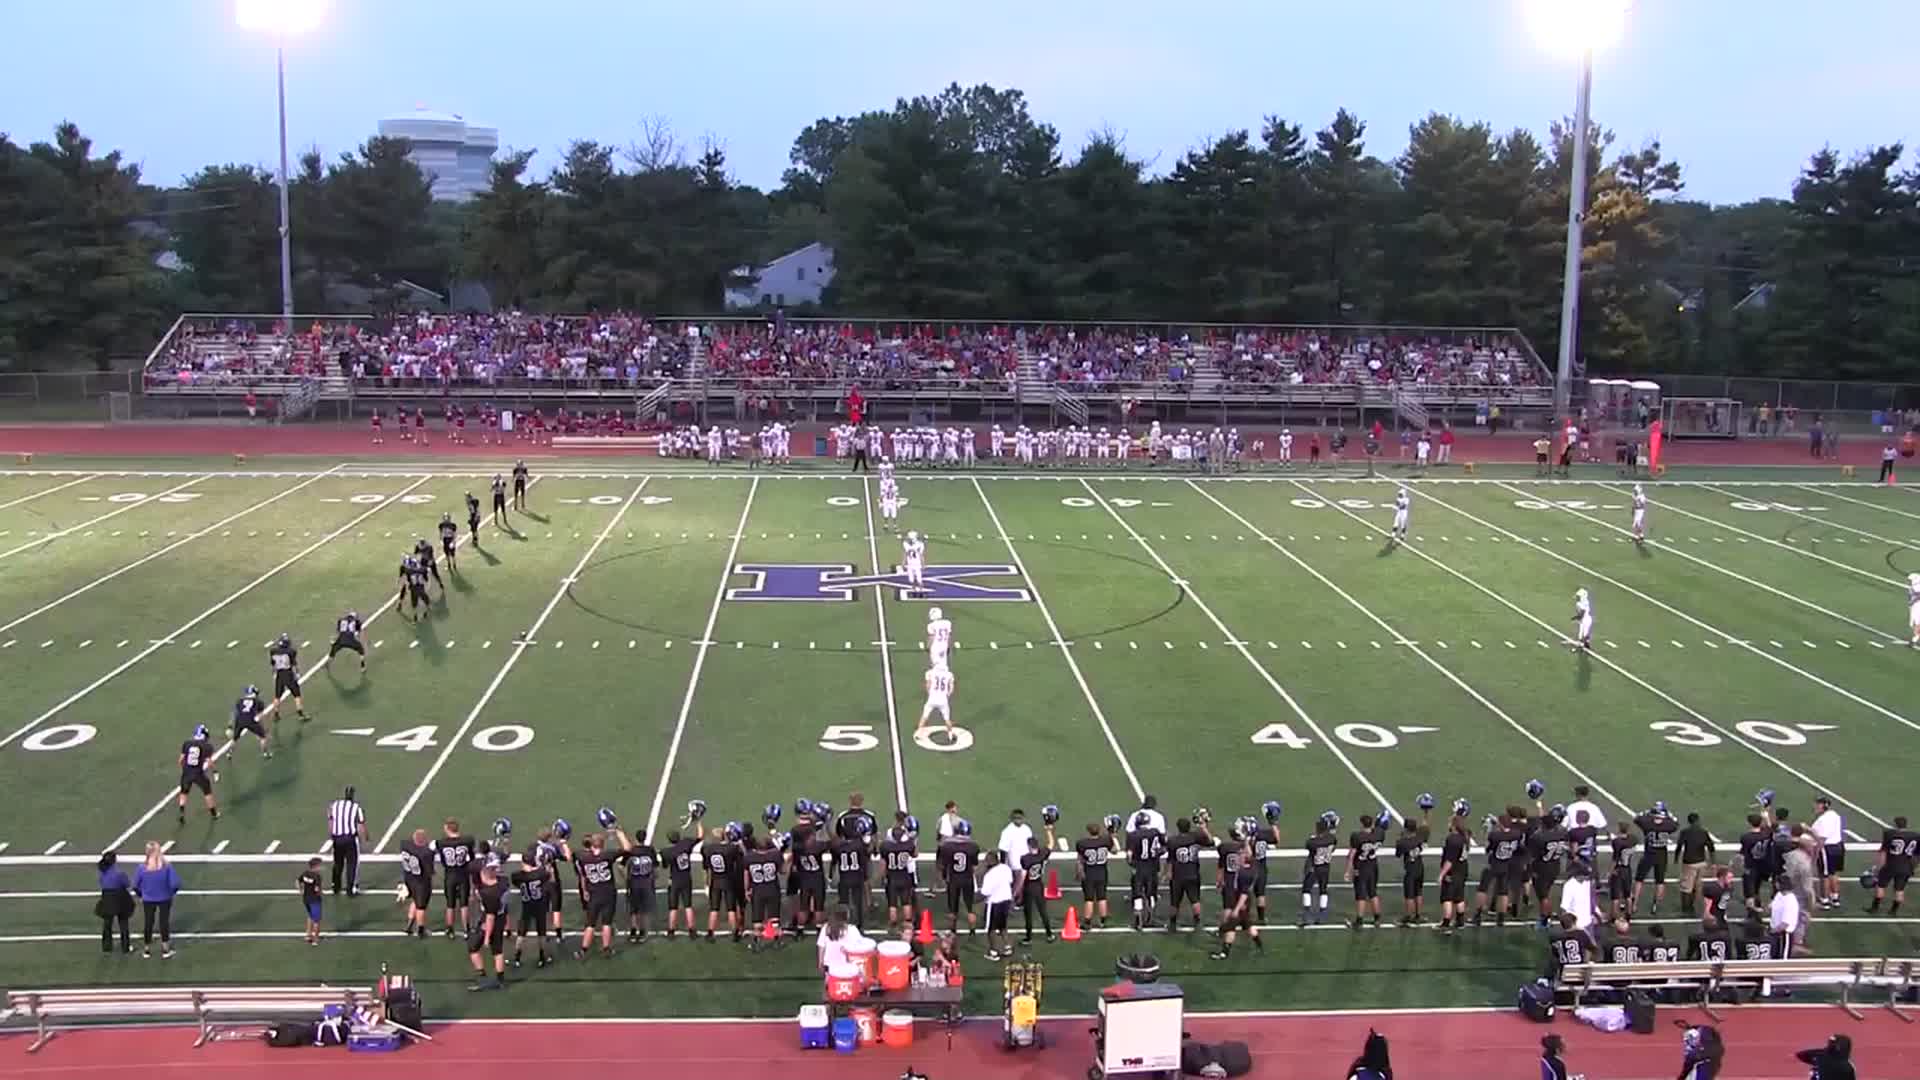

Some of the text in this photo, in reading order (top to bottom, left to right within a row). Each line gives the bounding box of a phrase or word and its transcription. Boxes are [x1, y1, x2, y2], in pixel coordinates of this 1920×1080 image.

[725, 563, 1033, 602] K
[376, 725, 535, 752] 40
[818, 725, 974, 751] 50
[1250, 722, 1398, 749] 40
[1649, 720, 1808, 746] 30
[186, 746, 201, 766] 2
[840, 851, 859, 871] 11
[953, 852, 967, 872] 3
[1553, 940, 1581, 963] 12
[1700, 941, 1726, 962] 13
